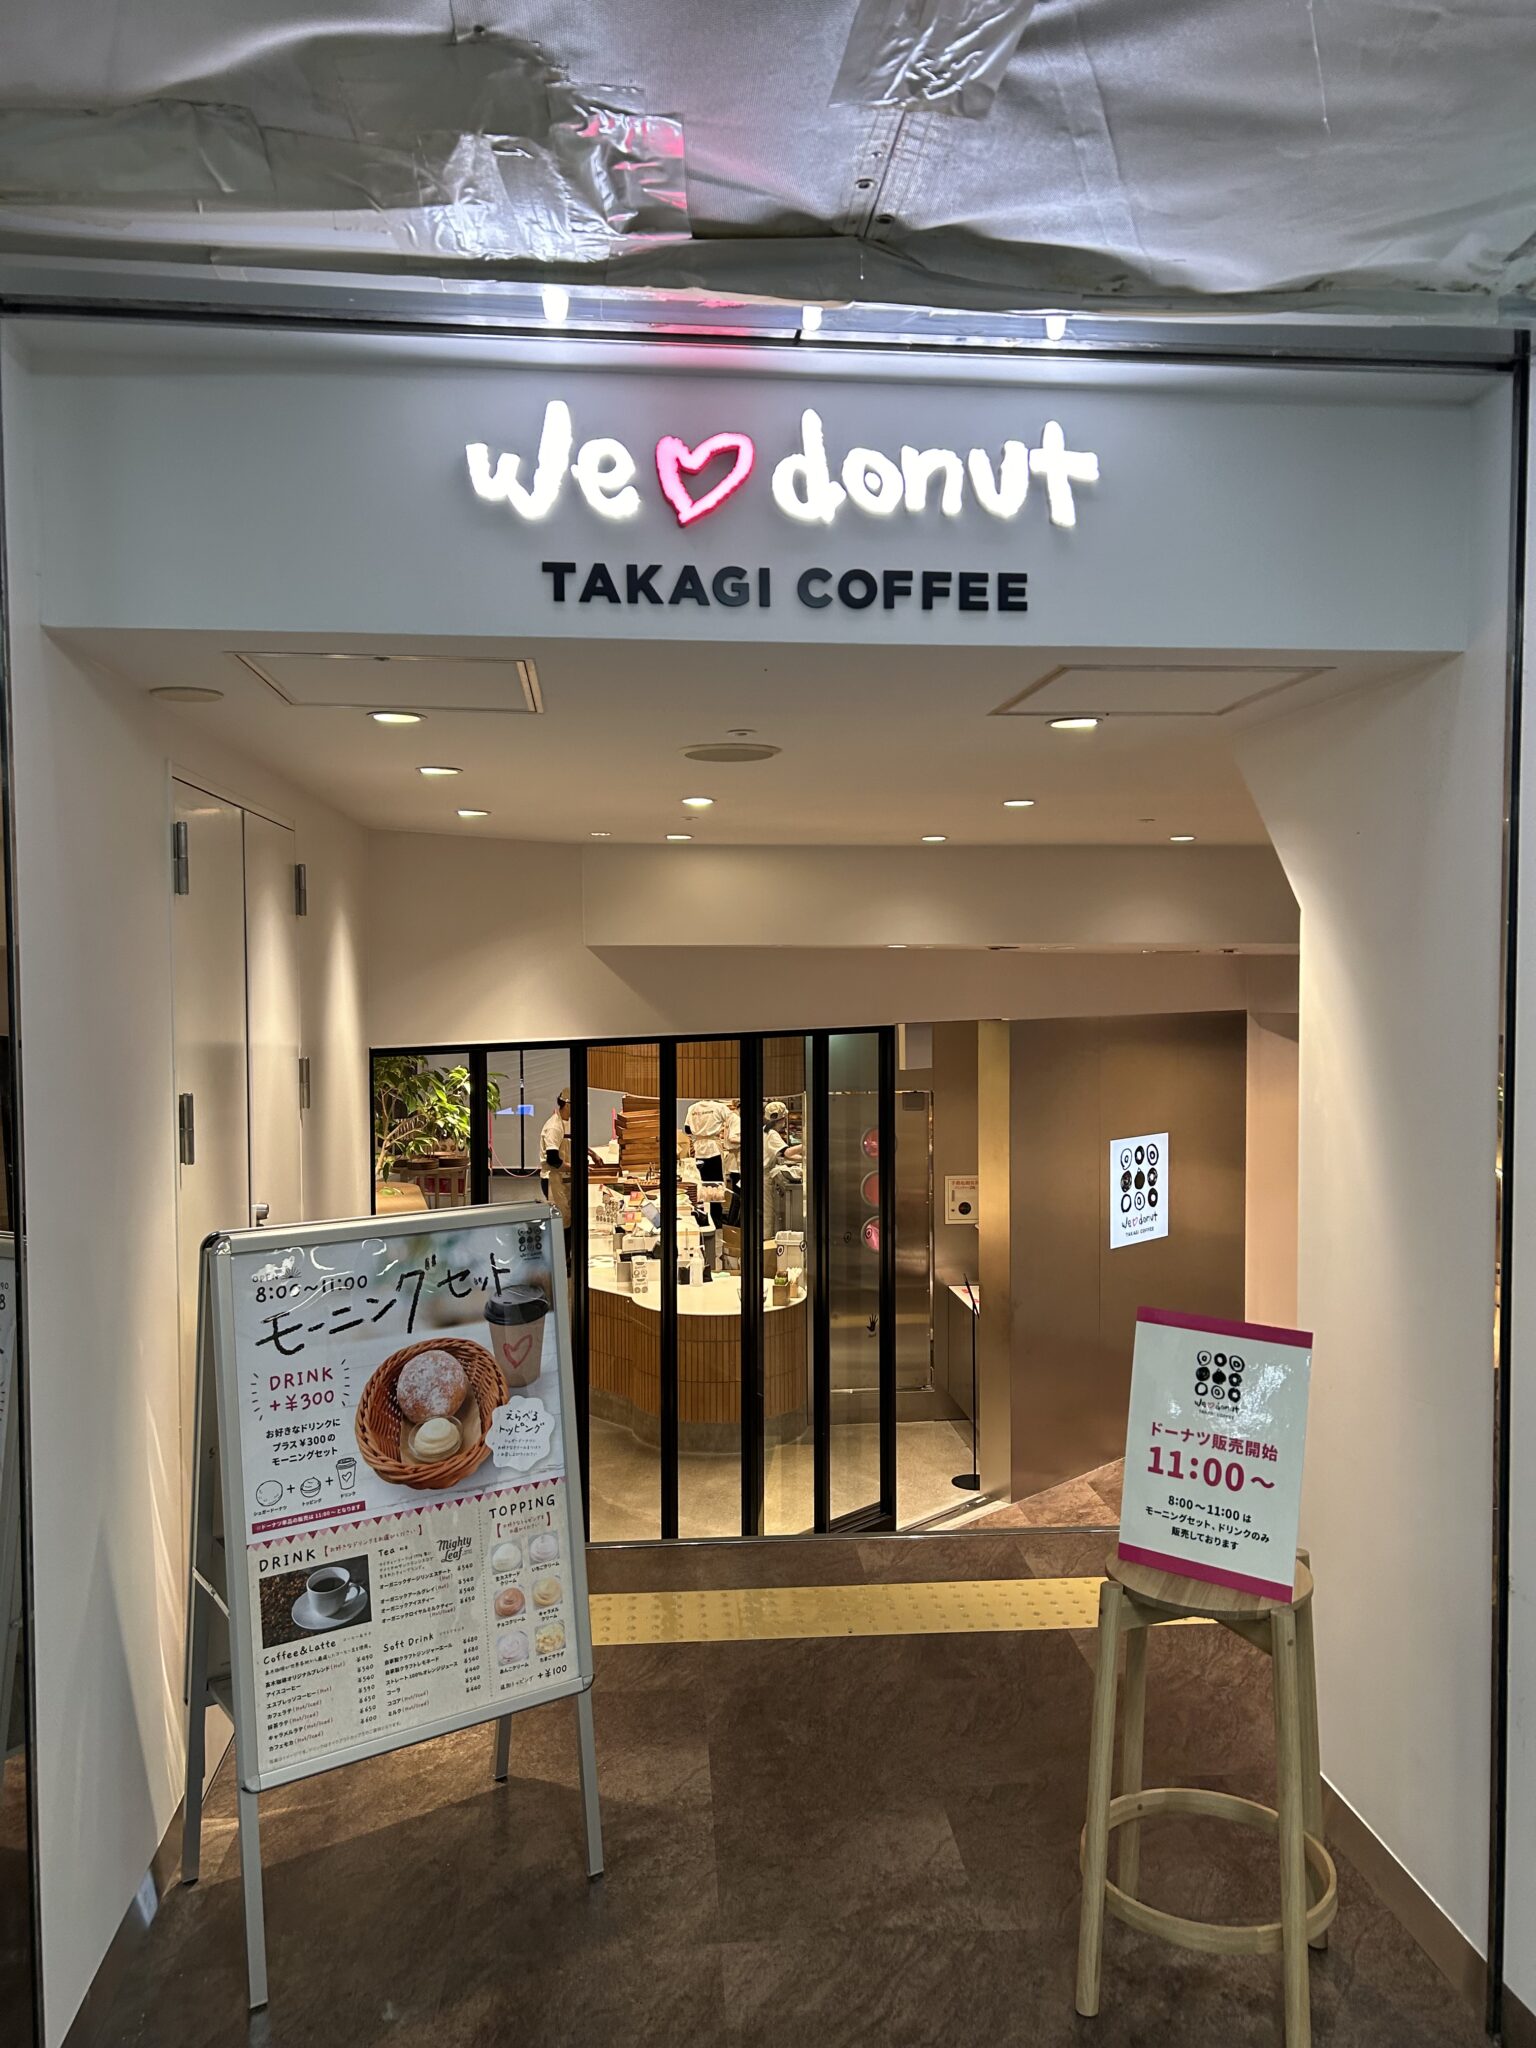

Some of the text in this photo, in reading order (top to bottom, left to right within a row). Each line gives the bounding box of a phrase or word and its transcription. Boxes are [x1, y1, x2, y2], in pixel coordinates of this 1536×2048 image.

[771, 408, 1100, 527] donut
[542, 561, 1029, 612] TAKAGI COFFEE
[269, 1367, 334, 1391] DRINK
[505, 1409, 538, 1421] えらべる
[266, 1418, 341, 1439] お好きなドリンクに
[499, 1422, 545, 1436] トッピング
[1150, 1422, 1279, 1463] ドーナツ販売開始
[272, 1446, 338, 1466] モーニングセット
[489, 1493, 555, 1519] TOPPING
[1145, 1505, 1270, 1544] モーニングセット、ドリンクのみ
[436, 1536, 472, 1551] Mighty
[1171, 1525, 1239, 1551] 販売しております
[259, 1548, 317, 1573] DRINK
[378, 1547, 395, 1557] Tea
[441, 1546, 463, 1563] Leaf
[263, 1640, 337, 1665] Coffee&Latte
[383, 1640, 405, 1652] Soft
[408, 1632, 434, 1646] Drink
[266, 1685, 301, 1698] アイスコーヒー
[386, 1687, 401, 1696] コーラ
